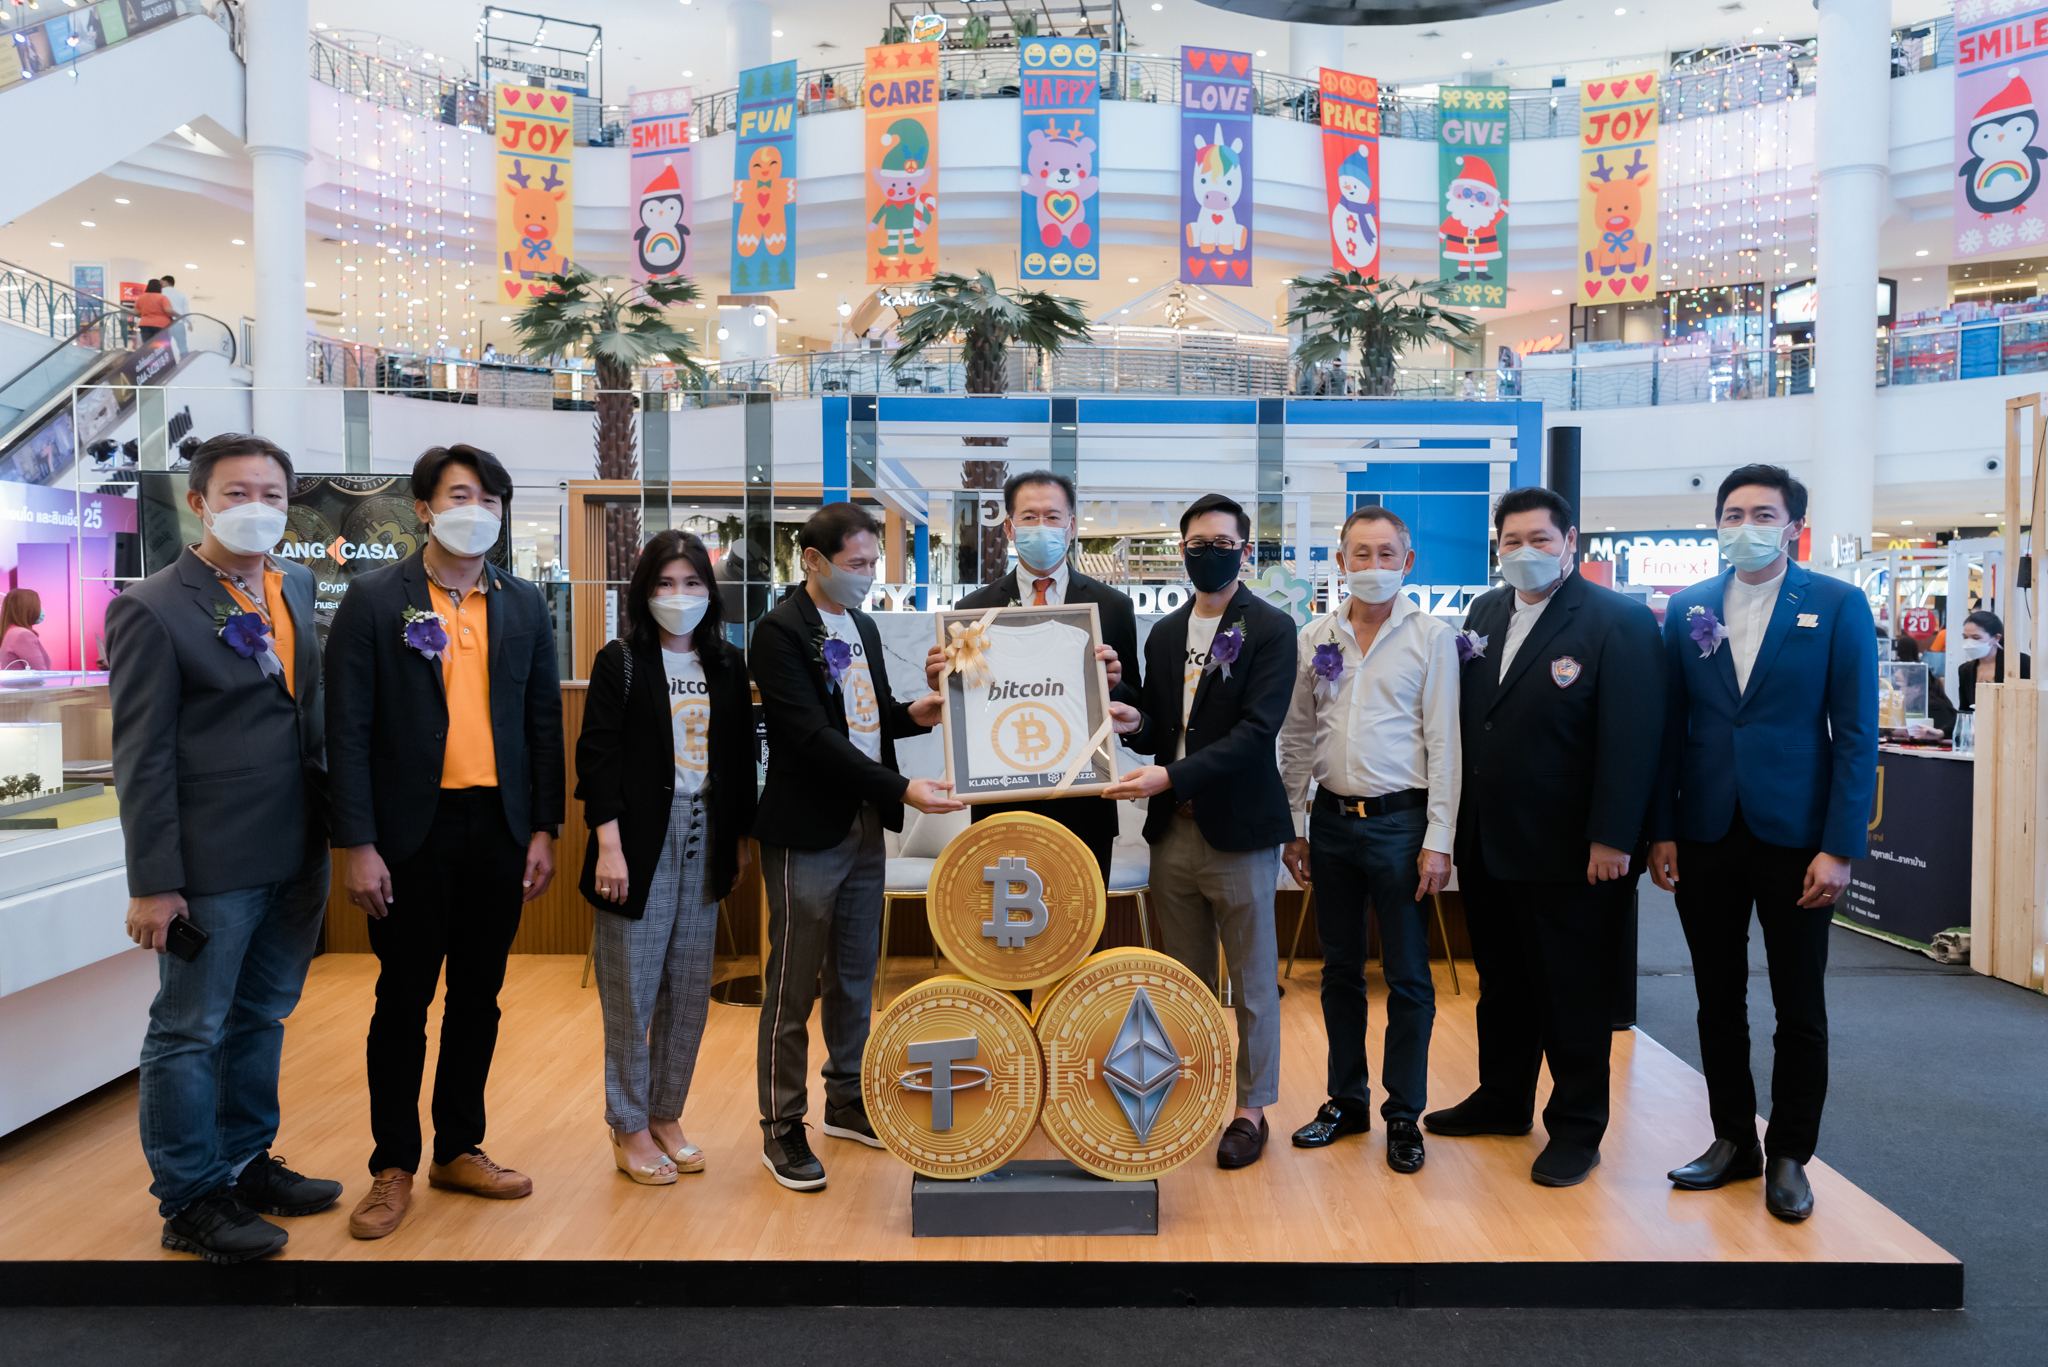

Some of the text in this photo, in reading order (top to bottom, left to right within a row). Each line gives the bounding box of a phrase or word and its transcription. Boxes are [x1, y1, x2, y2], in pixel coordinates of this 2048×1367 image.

[1959, 18, 2048, 64] SMILE
[868, 79, 935, 109] CARE
[1023, 78, 1097, 106] HAPPY
[1184, 82, 1250, 112] LOVE
[739, 104, 793, 137] FUN
[1322, 101, 1377, 135] PEACE
[1584, 107, 1655, 145] JOY
[501, 120, 569, 154] JOY
[632, 121, 690, 148] SMILE
[1441, 119, 1507, 146] GIVE
[83, 507, 102, 529] 25
[268, 542, 399, 559] LANG CASA
[988, 677, 1064, 701] bitcoin
[968, 776, 1030, 787] KLANG CASA
[980, 824, 1006, 837] BITCOIN
[1016, 824, 1065, 846] DECENTRALIZED
[1080, 867, 1093, 900] CURRENCY
[1081, 908, 1092, 933] BITCOIN
